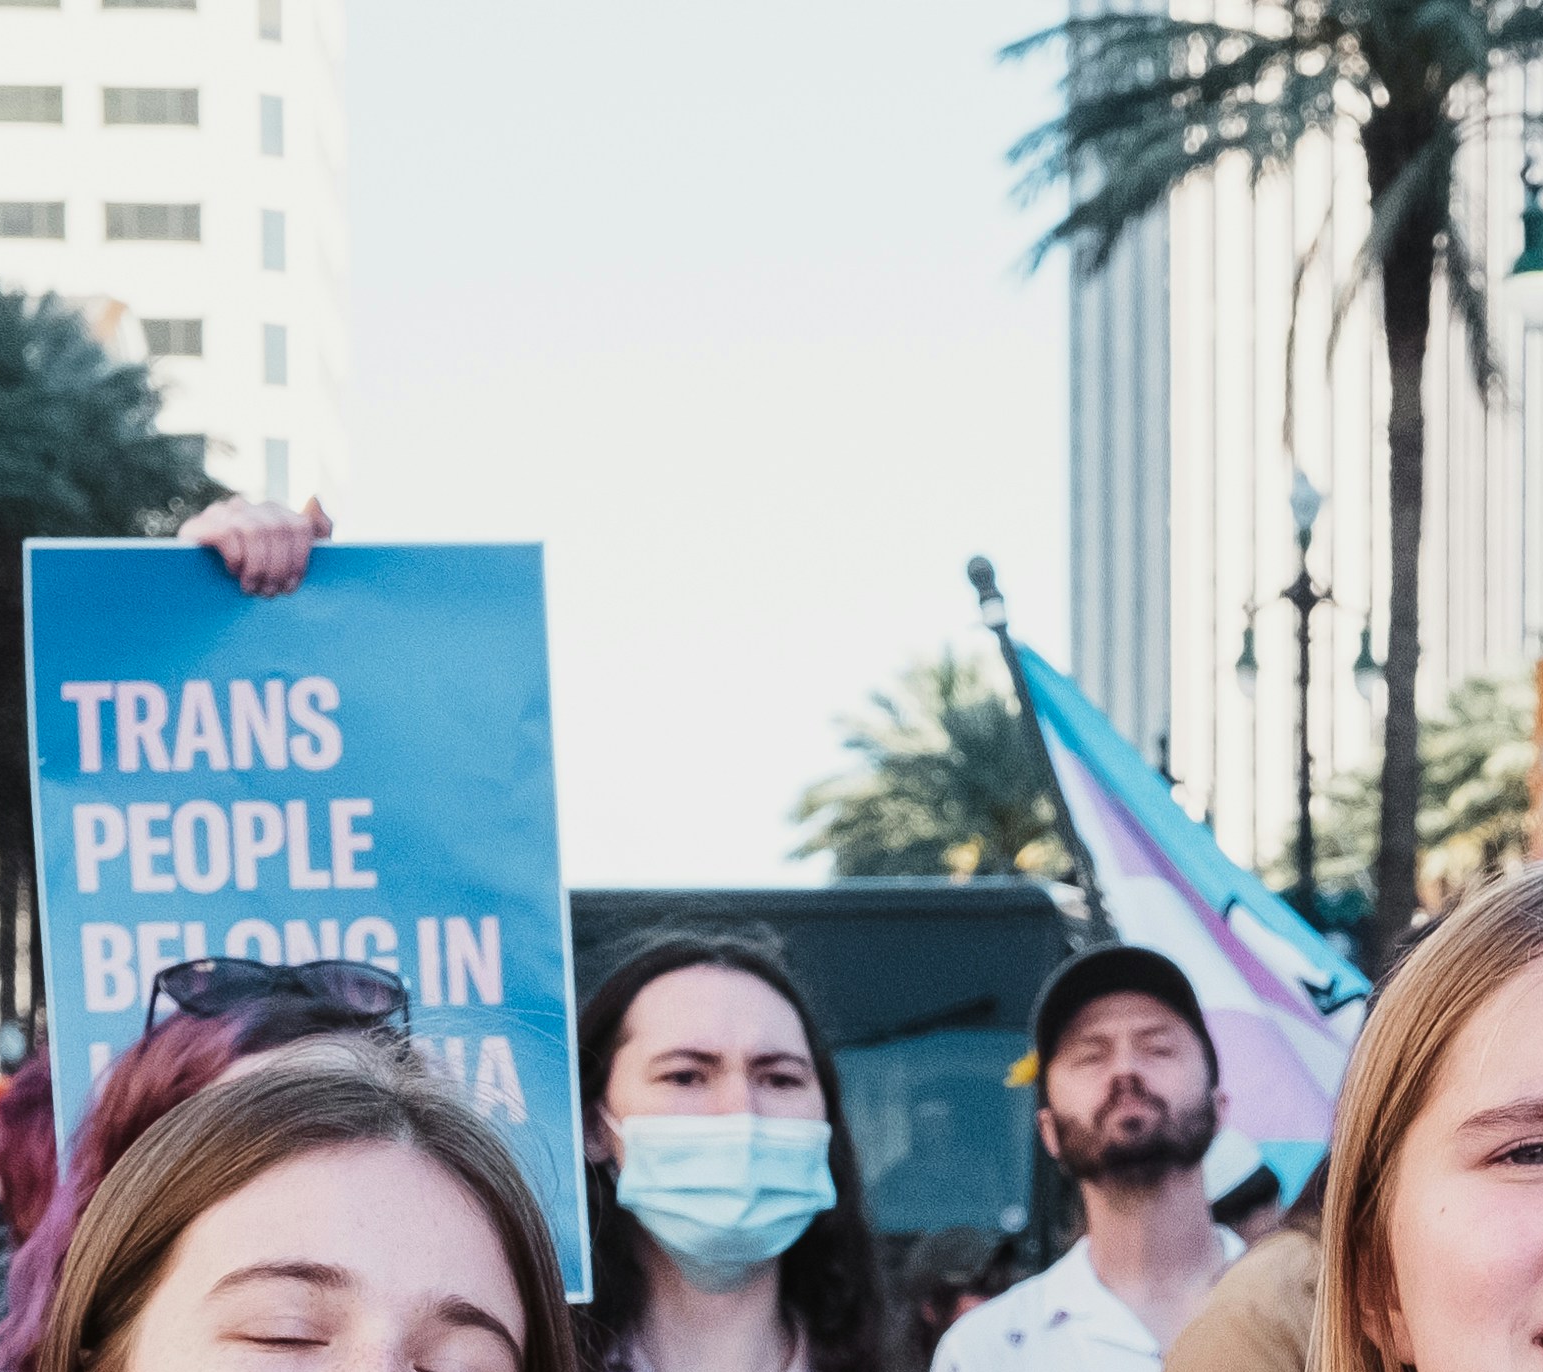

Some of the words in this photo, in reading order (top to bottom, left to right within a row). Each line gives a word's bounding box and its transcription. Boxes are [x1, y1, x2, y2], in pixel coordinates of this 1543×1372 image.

[61, 676, 344, 773] TRANS
[73, 798, 379, 894] PEOPLE
[417, 914, 504, 1006] IN
